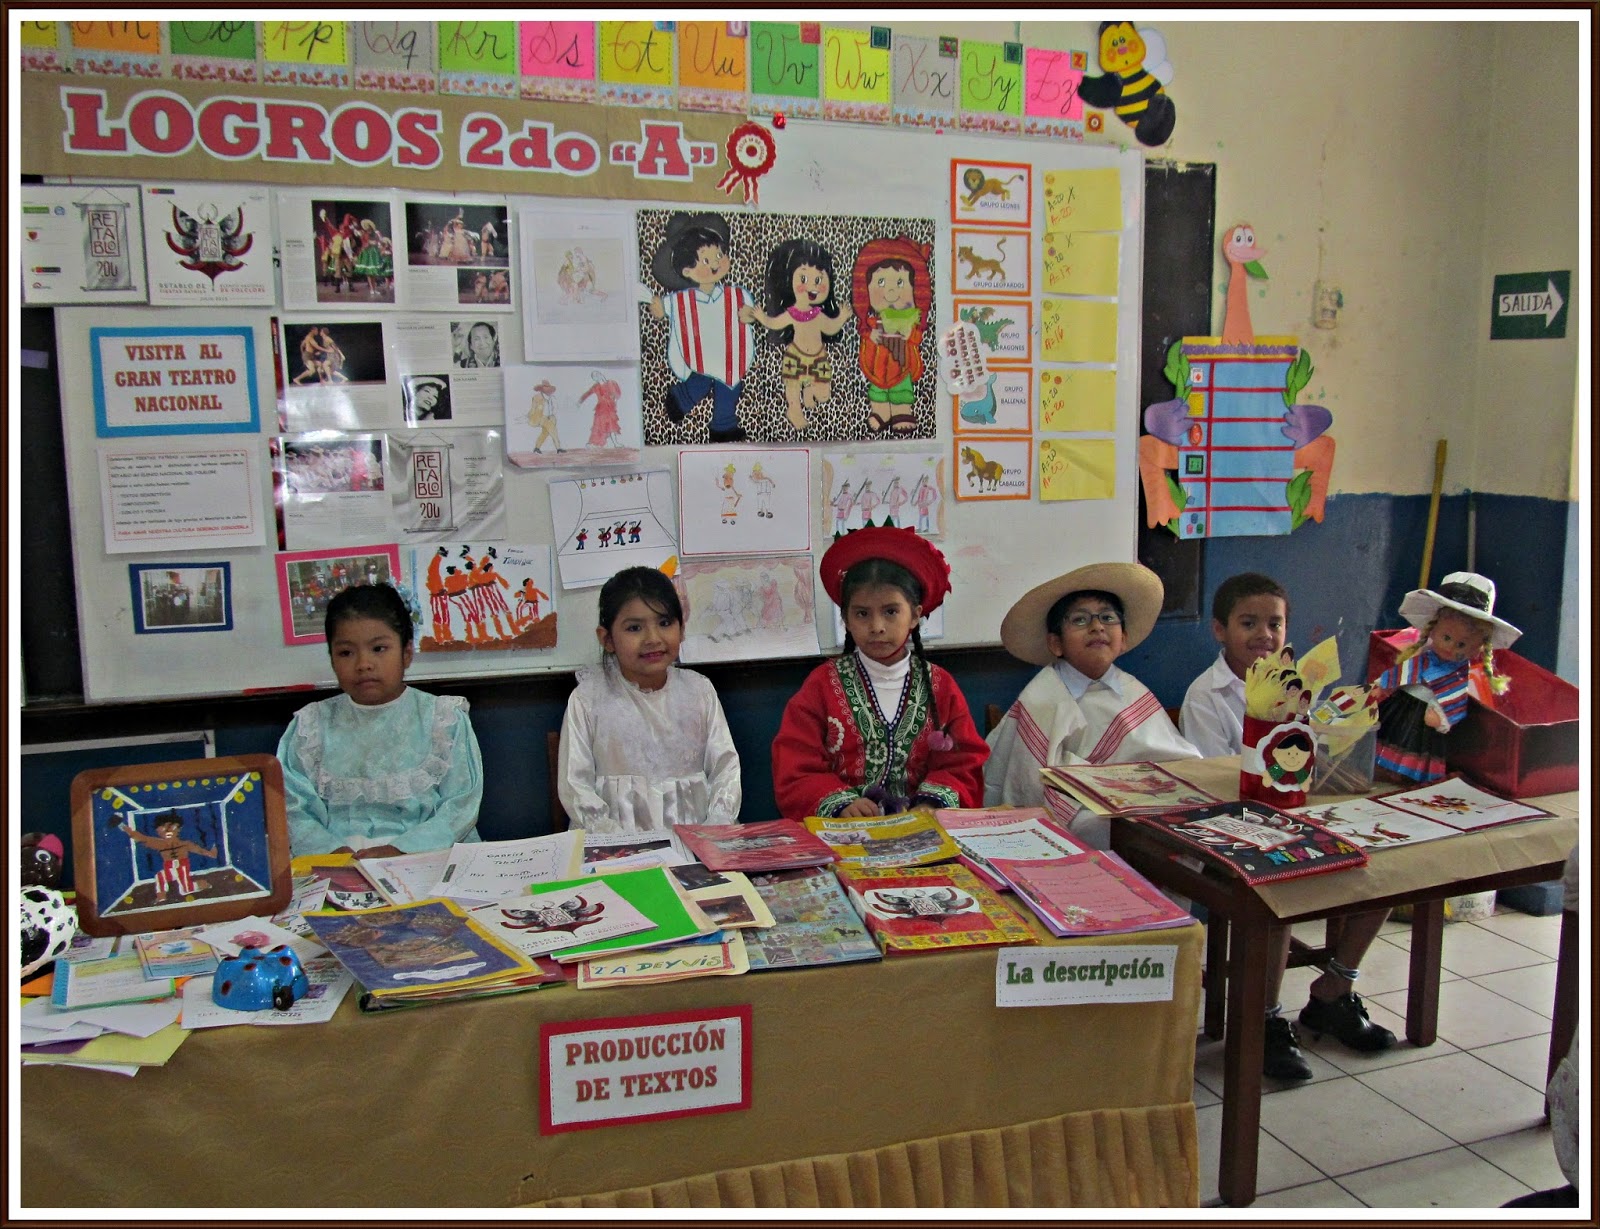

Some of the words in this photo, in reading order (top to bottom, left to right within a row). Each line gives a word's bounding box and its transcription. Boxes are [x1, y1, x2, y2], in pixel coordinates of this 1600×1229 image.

[66, 92, 439, 165] LOGROS
[466, 118, 597, 171] 2do
[993, 281, 1025, 289] LEOPARDOS
[1502, 294, 1553, 313] SALIDA
[125, 345, 186, 361] VISITA
[200, 344, 222, 359] AL
[115, 371, 162, 387] GRAN
[168, 369, 237, 385] TEATRO
[134, 395, 223, 412] NACIONAL
[1006, 962, 1034, 985] La
[1043, 957, 1165, 986] descripción
[565, 1024, 726, 1066] PRODUCCIÓN
[576, 1078, 610, 1102] DE
[621, 1065, 718, 1098] TEXTOS
